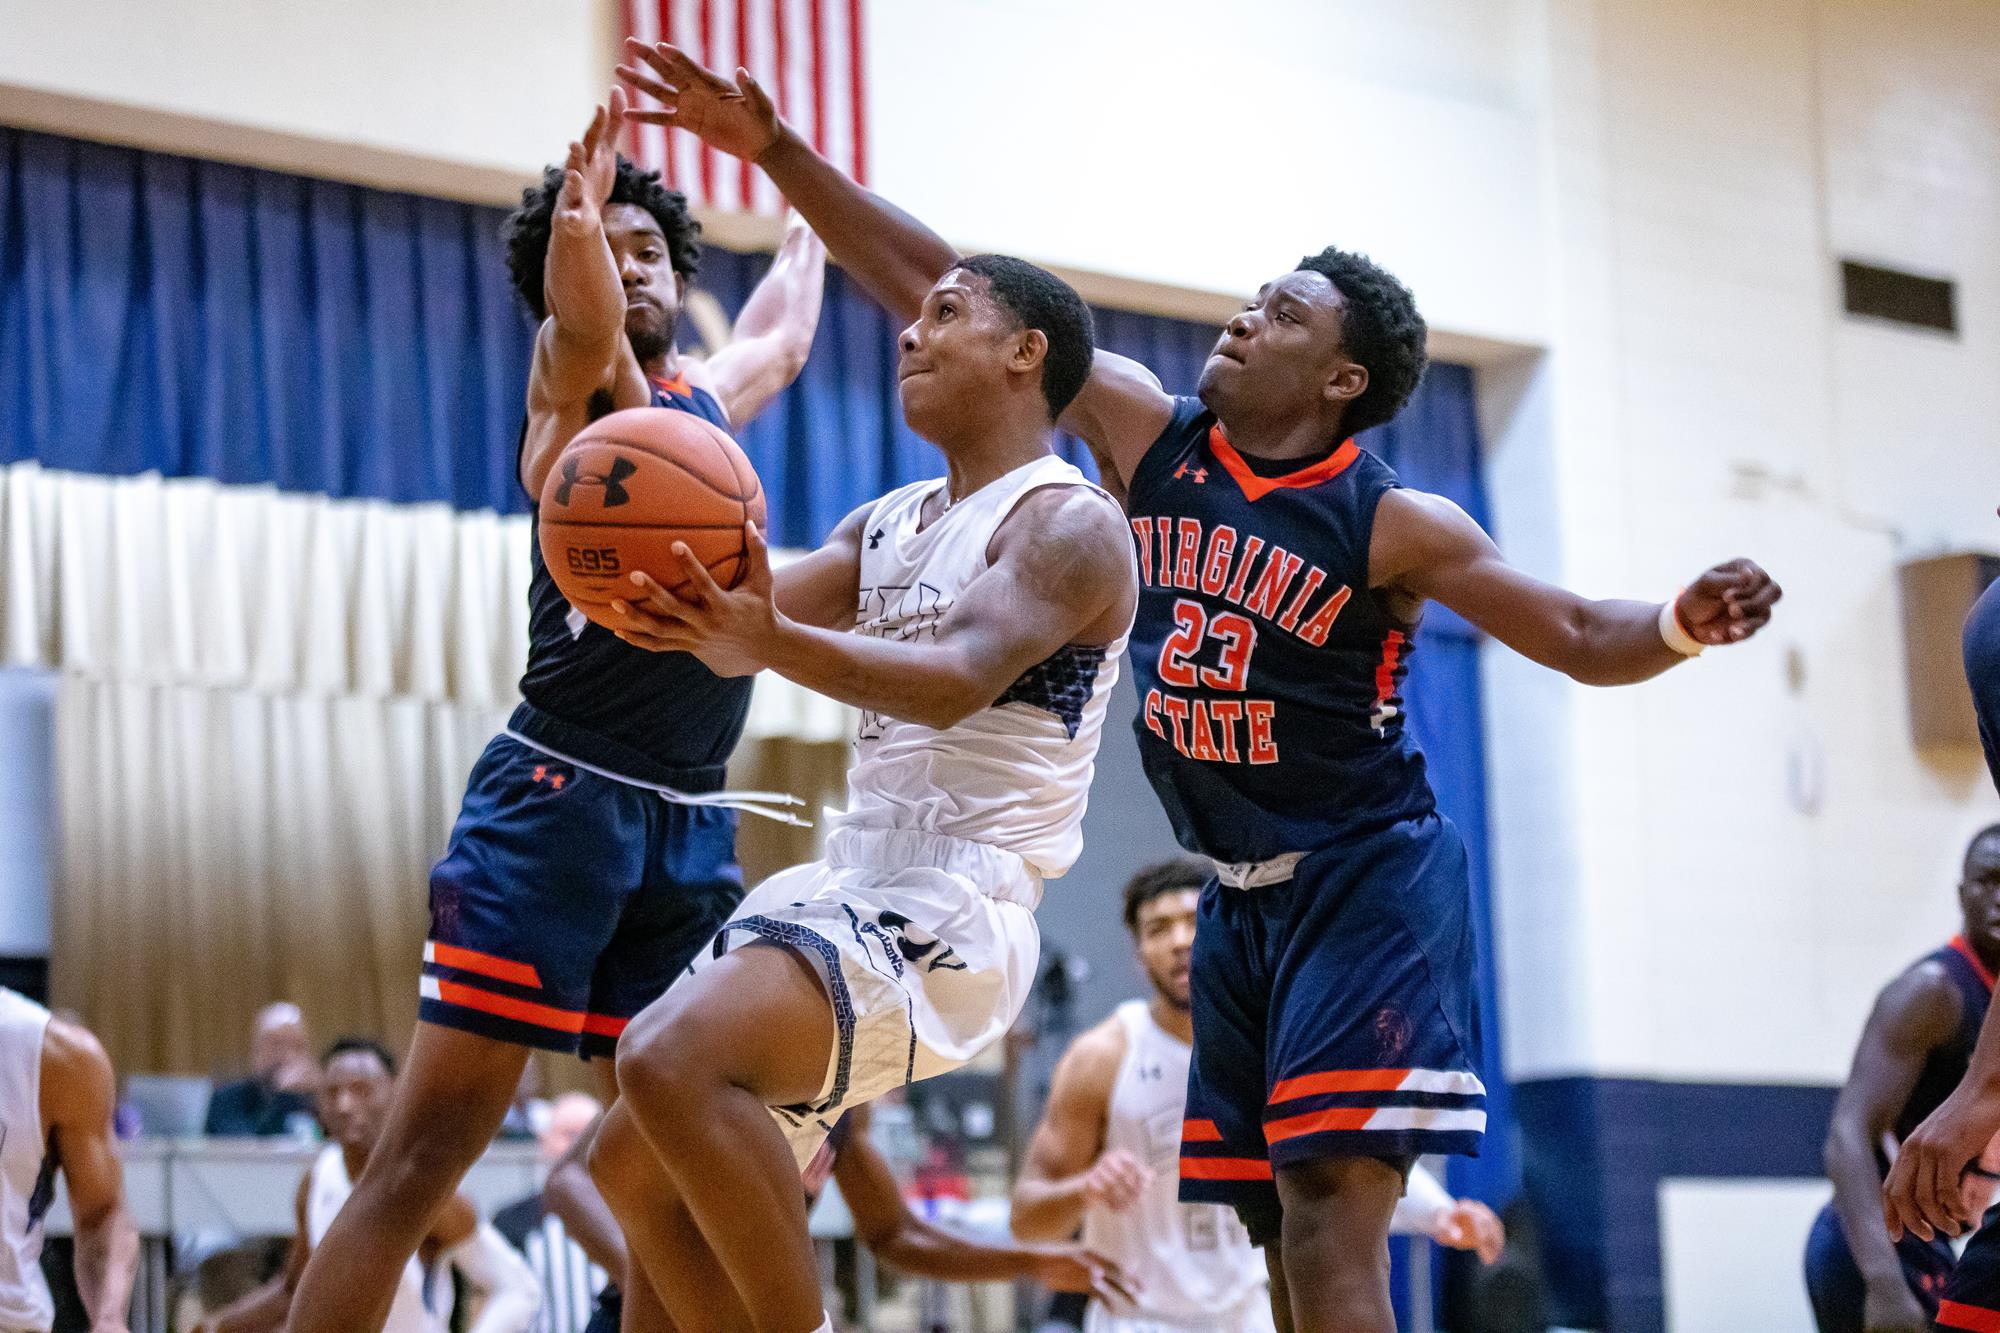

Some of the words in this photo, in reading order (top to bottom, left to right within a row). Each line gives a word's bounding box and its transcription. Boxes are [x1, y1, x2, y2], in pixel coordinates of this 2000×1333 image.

[568, 546, 622, 571] 695
[1131, 517, 1352, 647] VIRGINIA
[1158, 599, 1257, 691] 23
